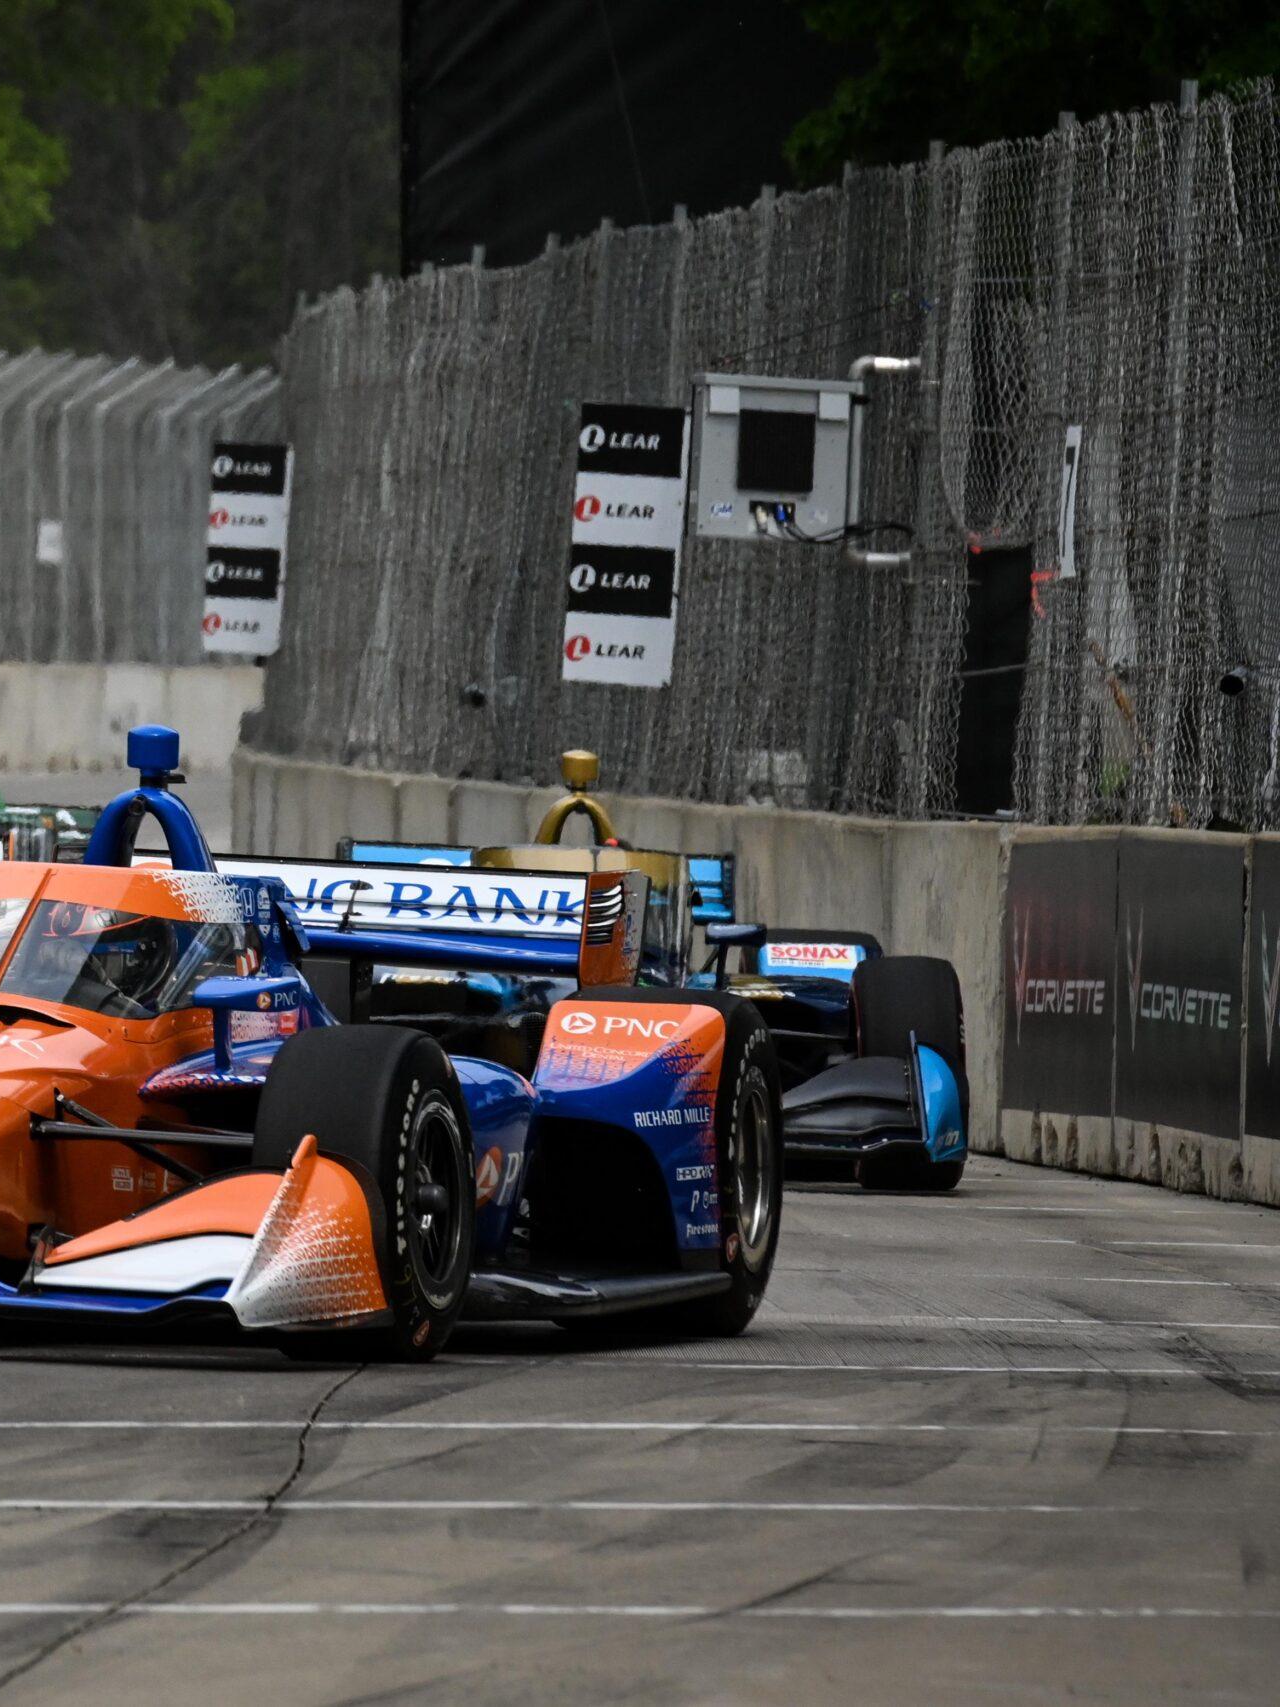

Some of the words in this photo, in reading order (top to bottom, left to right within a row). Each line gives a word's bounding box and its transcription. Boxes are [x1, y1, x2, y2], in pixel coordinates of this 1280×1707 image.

[608, 431, 660, 451] LEAR
[234, 460, 272, 476] LEAR
[231, 514, 268, 528] LEAR
[605, 504, 655, 520] LEAR
[226, 566, 264, 581] LEAR
[600, 571, 651, 590] LEAR
[223, 619, 261, 634] LEAR
[595, 643, 646, 661] LEAR
[384, 881, 586, 927] BANK
[771, 945, 849, 960] SONAX
[274, 990, 298, 1008] PNC
[1024, 978, 1106, 1015] CORVETTE
[1140, 982, 1231, 1030] CORVETTE
[603, 1016, 681, 1039] PNC
[633, 1109, 683, 1128] RICHARD
[684, 1106, 711, 1124] MILLE
